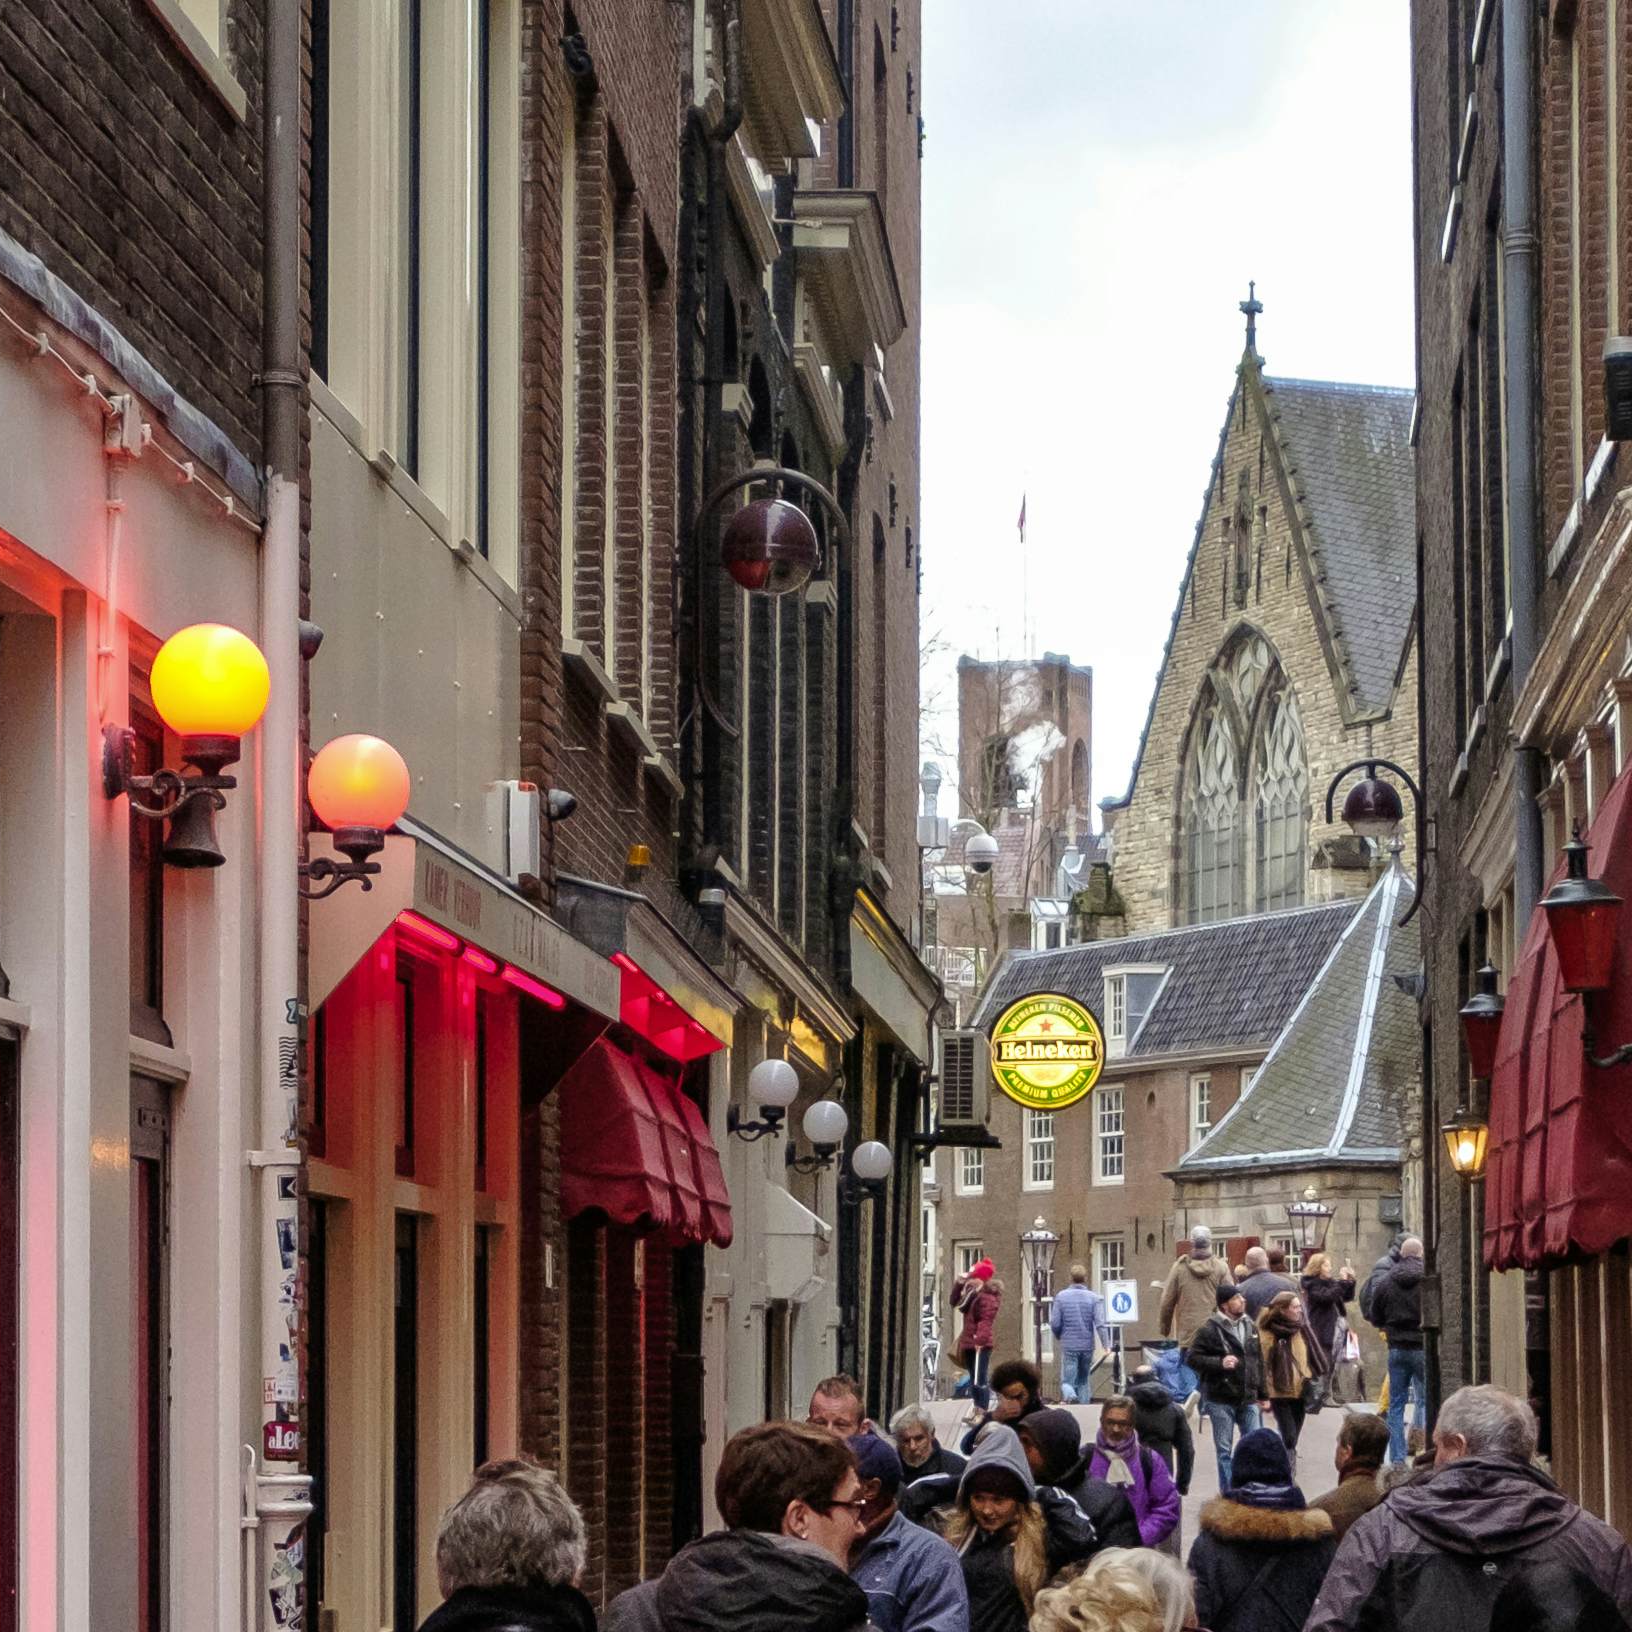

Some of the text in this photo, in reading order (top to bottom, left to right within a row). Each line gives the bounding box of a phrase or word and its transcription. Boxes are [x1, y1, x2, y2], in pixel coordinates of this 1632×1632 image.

[1001, 1040, 1093, 1060] Heineken
[1008, 1072, 1087, 1099] PREMIUM QUALITY
